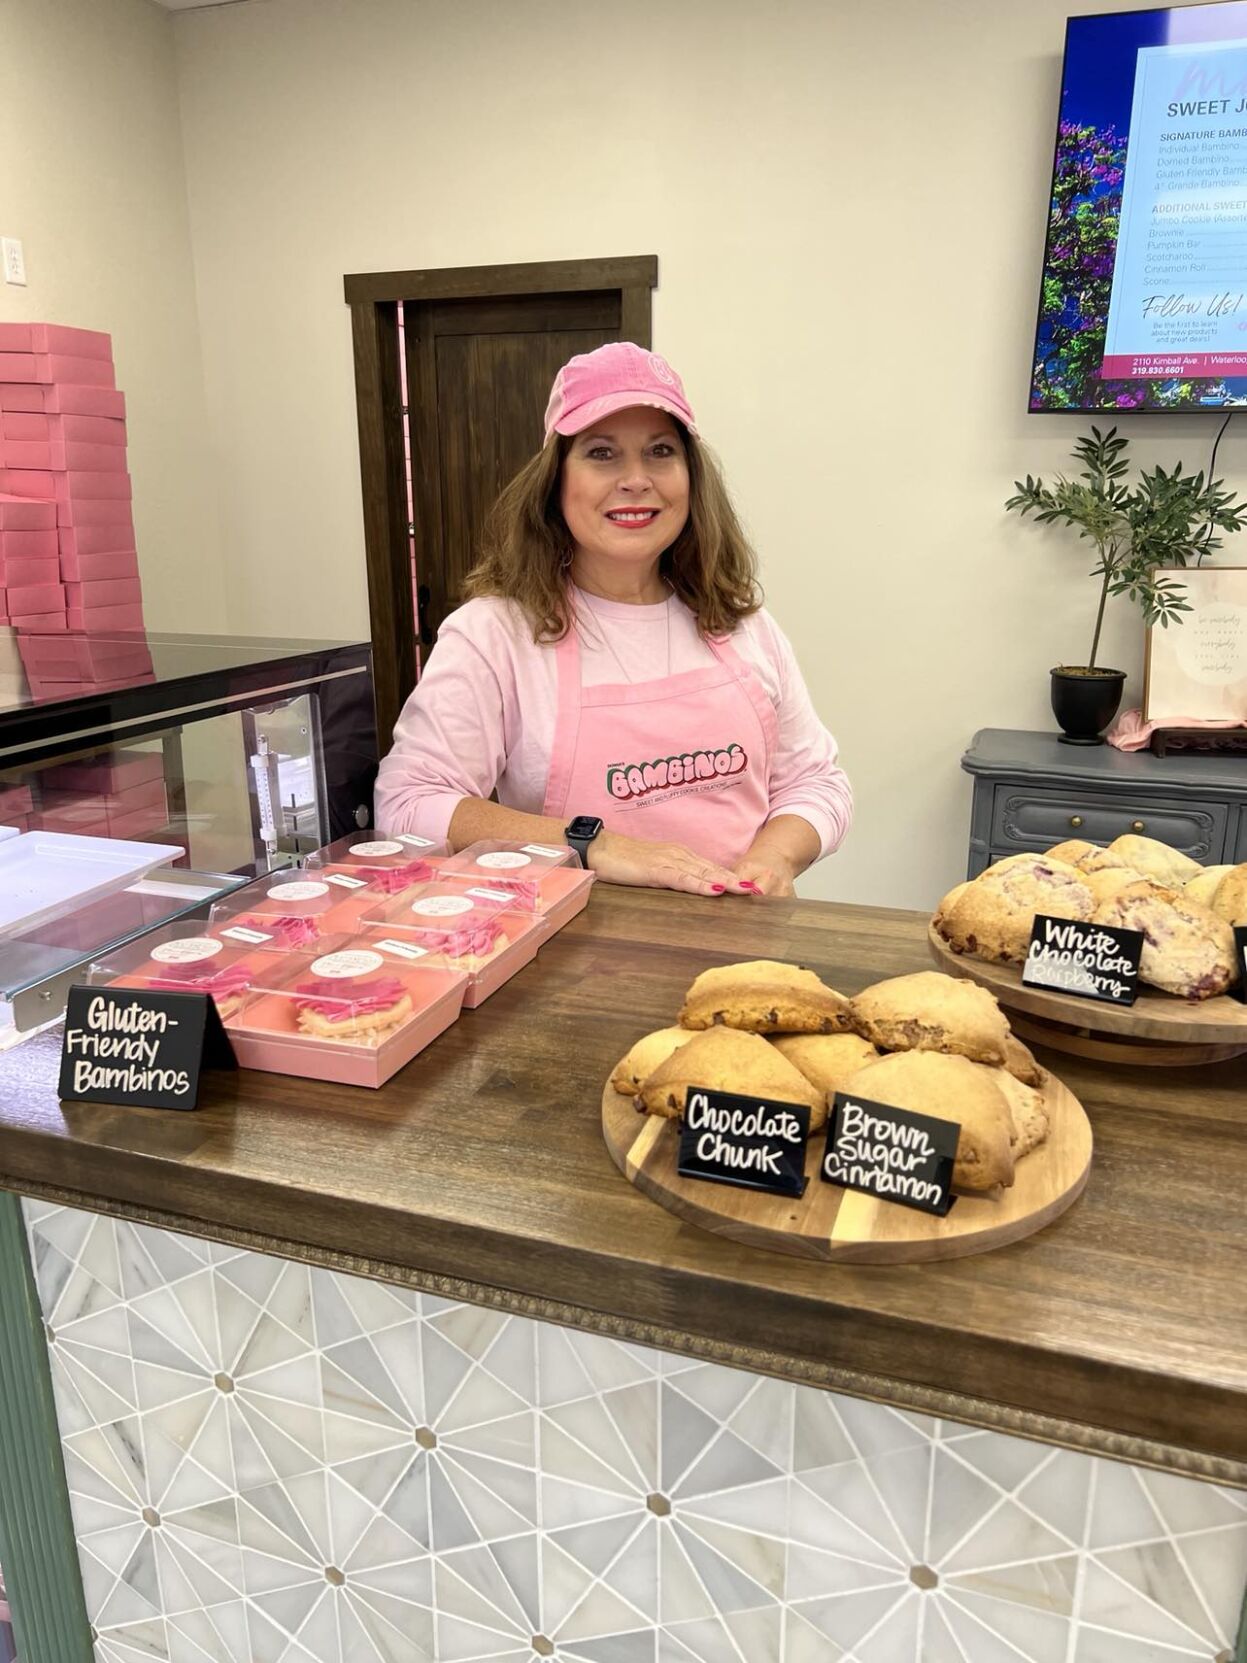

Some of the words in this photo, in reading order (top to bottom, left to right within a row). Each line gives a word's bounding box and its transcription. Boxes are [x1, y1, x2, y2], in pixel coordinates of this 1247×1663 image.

[1167, 99, 1231, 118] SWEET
[1235, 98, 1247, 113] J
[1160, 130, 1216, 142] SIGNATURE
[1159, 143, 1200, 154] Individual
[1201, 142, 1240, 152] Bambino
[1157, 156, 1189, 167] Domed
[1191, 154, 1230, 165] Bambino
[1155, 168, 1184, 179] Gluten
[1186, 167, 1221, 177] Friendly
[1151, 202, 1210, 214] ADDITIONAL
[1148, 228, 1184, 238] Brownie
[1147, 240, 1185, 250] Pumpkin
[1186, 239, 1201, 249] Bar
[1145, 252, 1194, 262] Scotcharoo
[1144, 264, 1188, 274] Cinnamon
[1143, 277, 1170, 286] Scone
[1142, 293, 1202, 319] Follow
[1206, 291, 1244, 318] Us!
[1164, 321, 1175, 329] the
[1176, 320, 1191, 328] first
[1192, 320, 1200, 328] to
[1187, 328, 1218, 336] products
[1132, 358, 1152, 366] 2110
[1153, 356, 1181, 365] Kimball
[1131, 366, 1184, 375] 319.830.6601
[635, 797, 654, 808] SWEET
[1045, 919, 1120, 955] White
[1028, 939, 1137, 976] Chocolate
[87, 996, 179, 1034] Gluten-
[73, 1060, 190, 1095] Bambinos
[688, 1093, 802, 1142] Chocolate
[842, 1102, 935, 1156] Brown
[697, 1133, 784, 1175] Chunk
[836, 1136, 928, 1173] Sugar
[824, 1153, 942, 1206] Cinnamon
